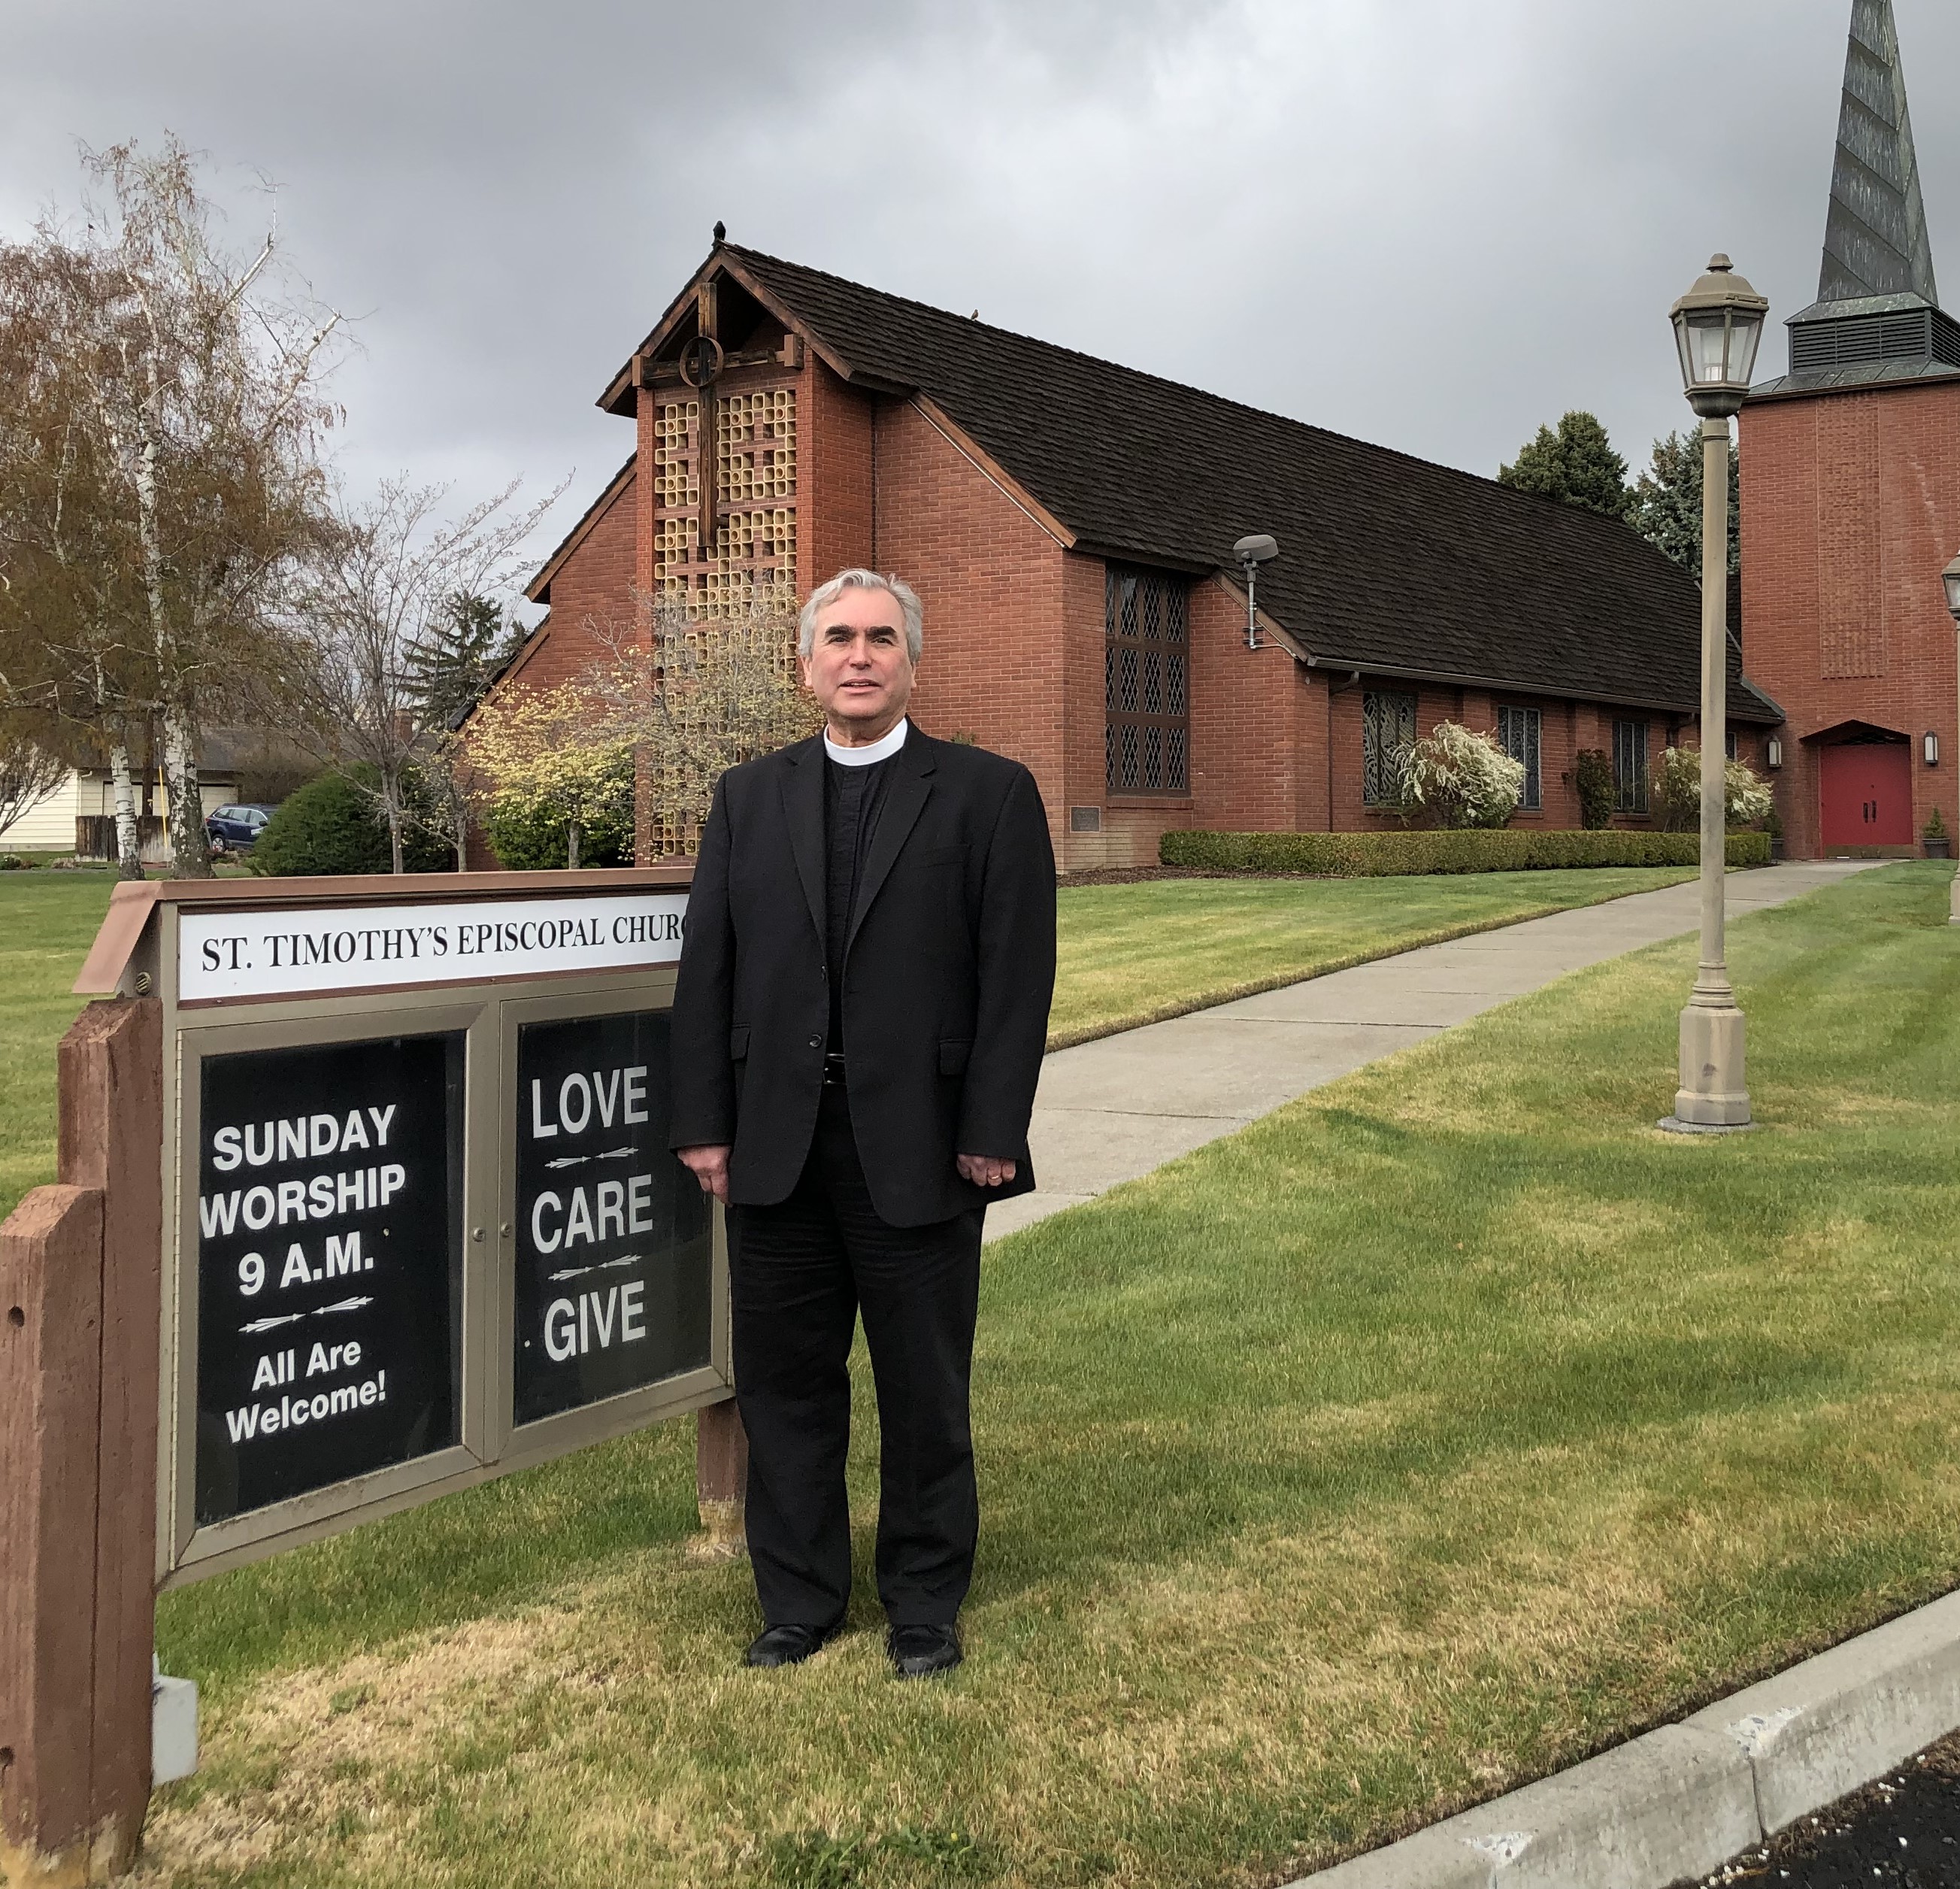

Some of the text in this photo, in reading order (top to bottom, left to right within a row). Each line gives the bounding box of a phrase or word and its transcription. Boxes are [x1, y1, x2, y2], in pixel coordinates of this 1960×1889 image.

[201, 913, 686, 972] ST. TIMOTHY'S EPISCOPAL CHUR
[213, 1104, 396, 1171] SUNDAY
[531, 1065, 650, 1139] LOVE
[199, 1163, 406, 1239] WORSHIP
[531, 1173, 653, 1254] CARE
[238, 1230, 374, 1296] 9 A.M.
[544, 1280, 647, 1362] GIVE
[251, 1341, 362, 1392] All Are
[225, 1369, 386, 1444] Welcome!
